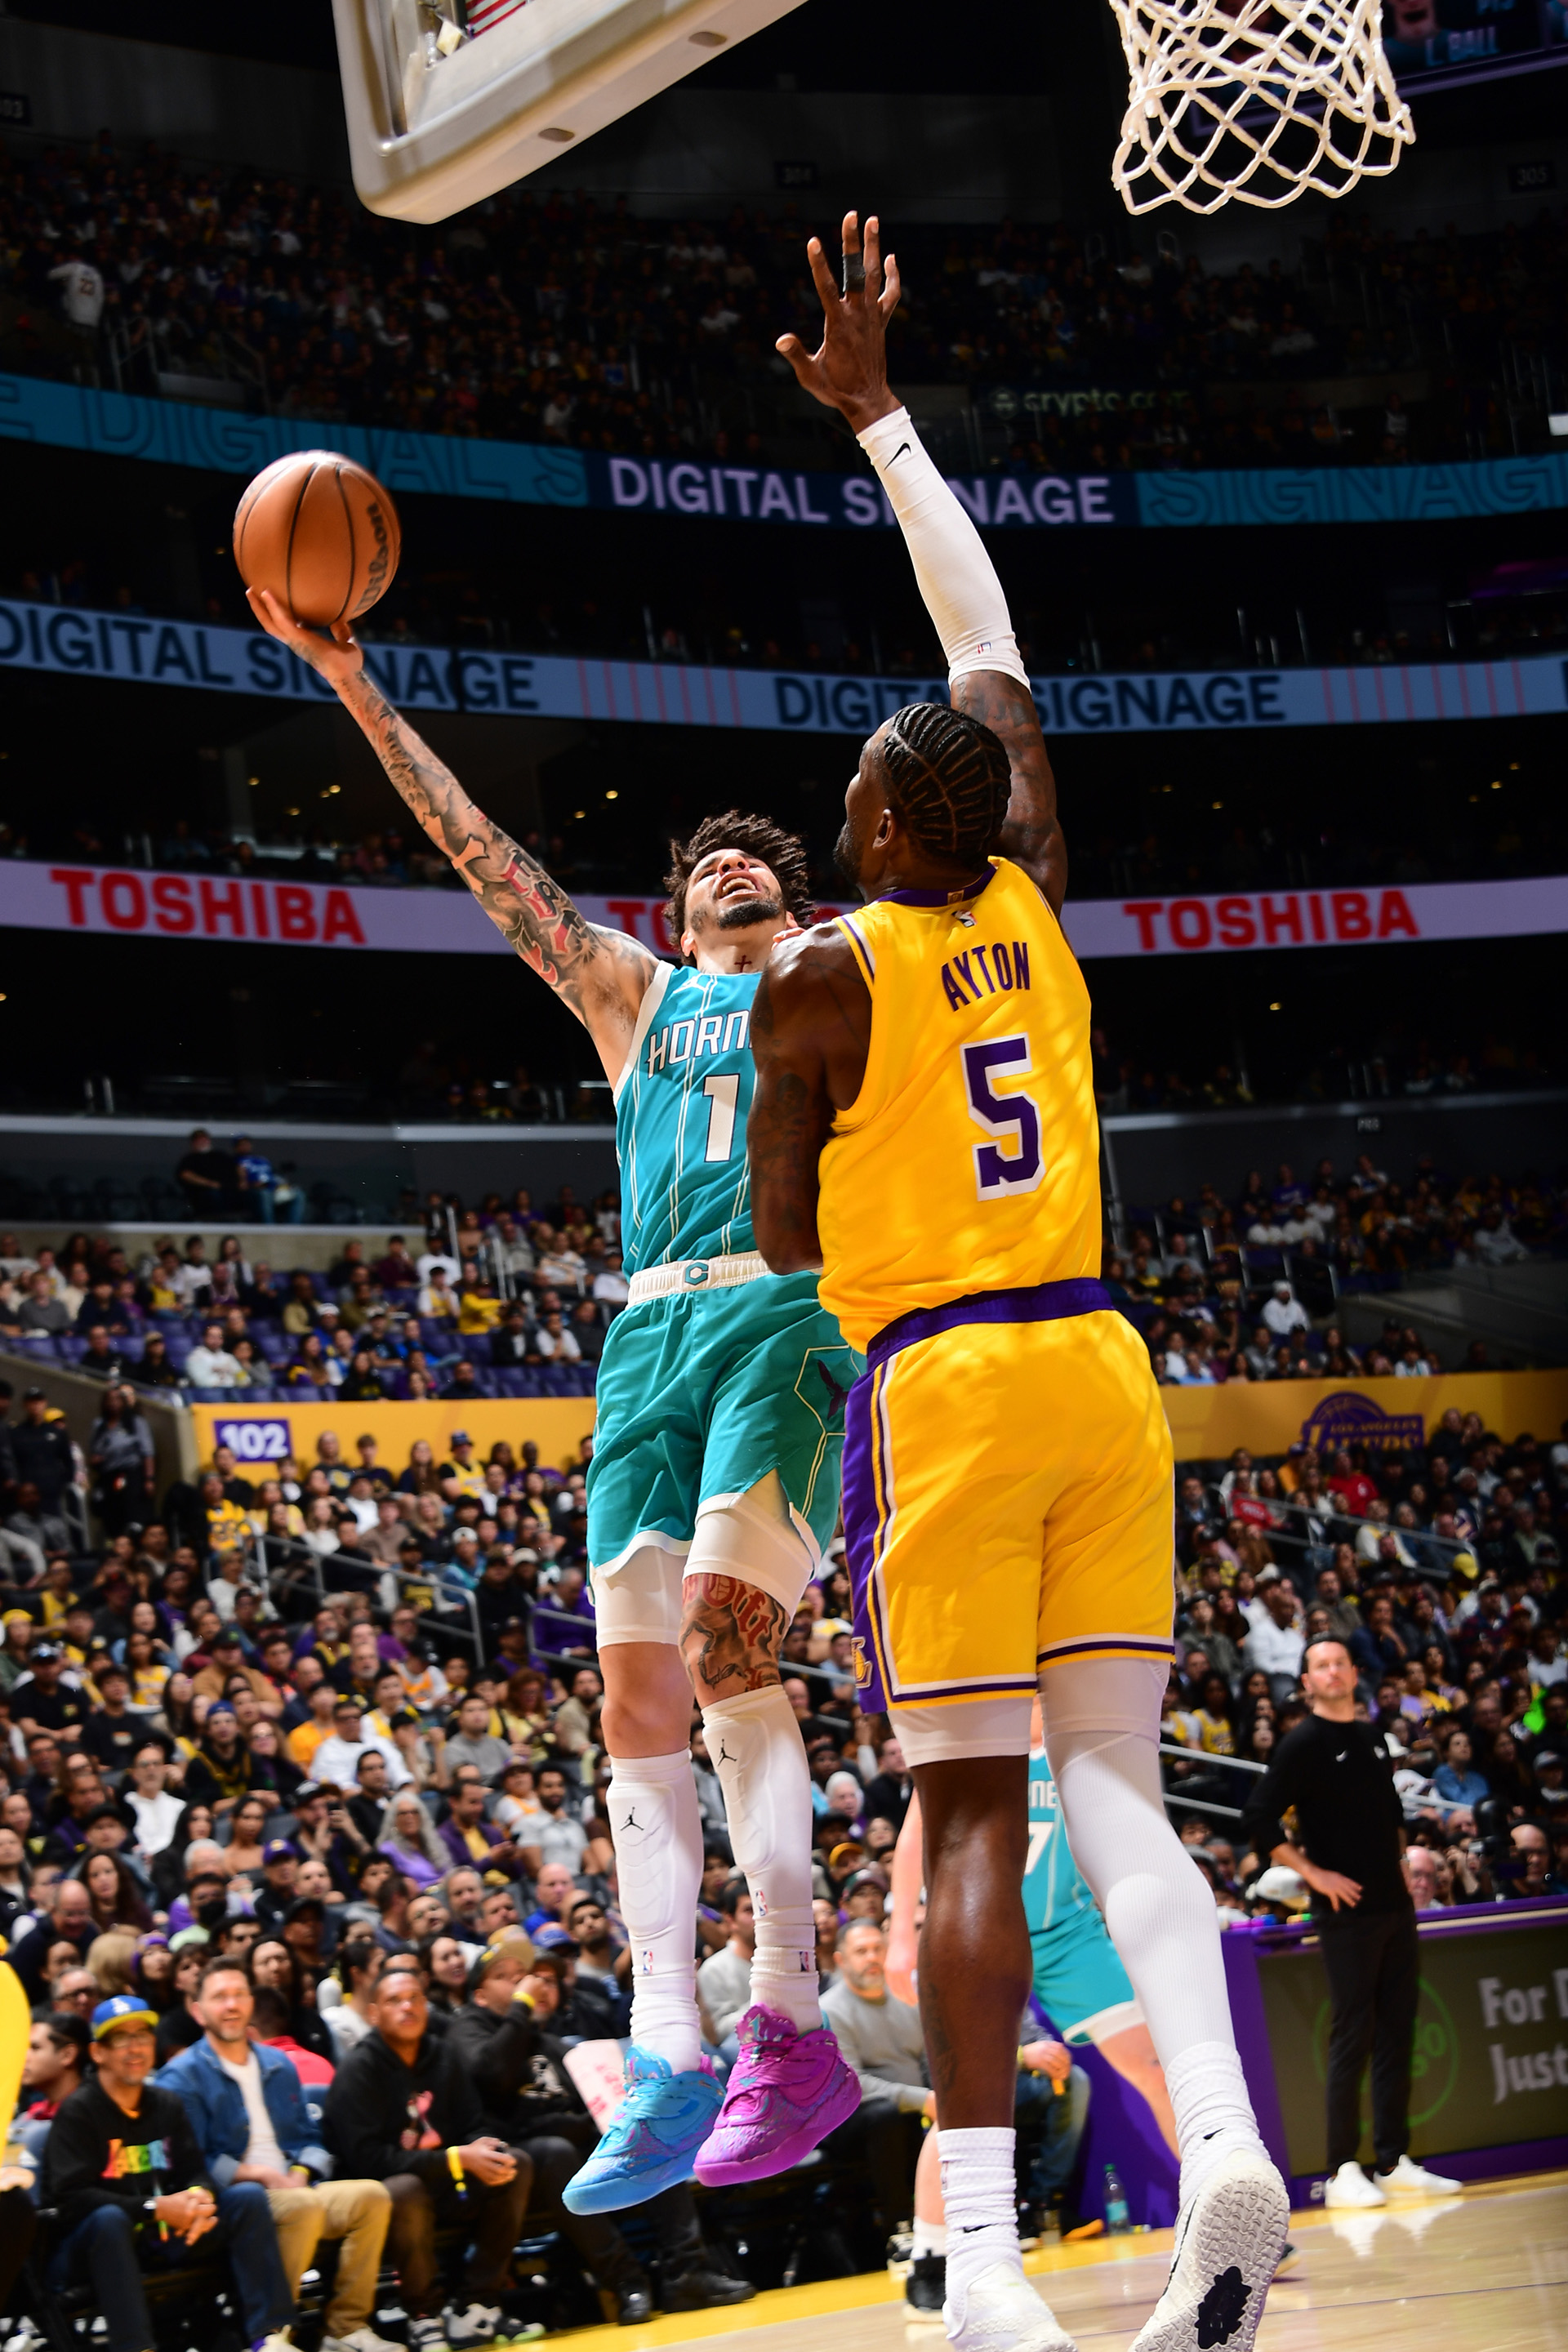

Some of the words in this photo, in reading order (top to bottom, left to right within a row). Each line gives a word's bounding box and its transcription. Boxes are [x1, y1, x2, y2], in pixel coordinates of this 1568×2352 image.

[609, 457, 830, 523] DIGITAL
[842, 477, 1115, 527] SINAGE
[246, 636, 539, 710] SINAGE
[49, 869, 366, 945] TOSHIBA
[1122, 889, 1420, 951] TOSHIBA
[941, 942, 1030, 1012] AYTON
[645, 1009, 752, 1080] HORN
[702, 1073, 740, 1162] 1
[960, 1031, 1046, 1202] 5
[220, 1423, 288, 1459] 102
[1479, 1976, 1548, 2027] For
[1489, 2042, 1568, 2105] Just
